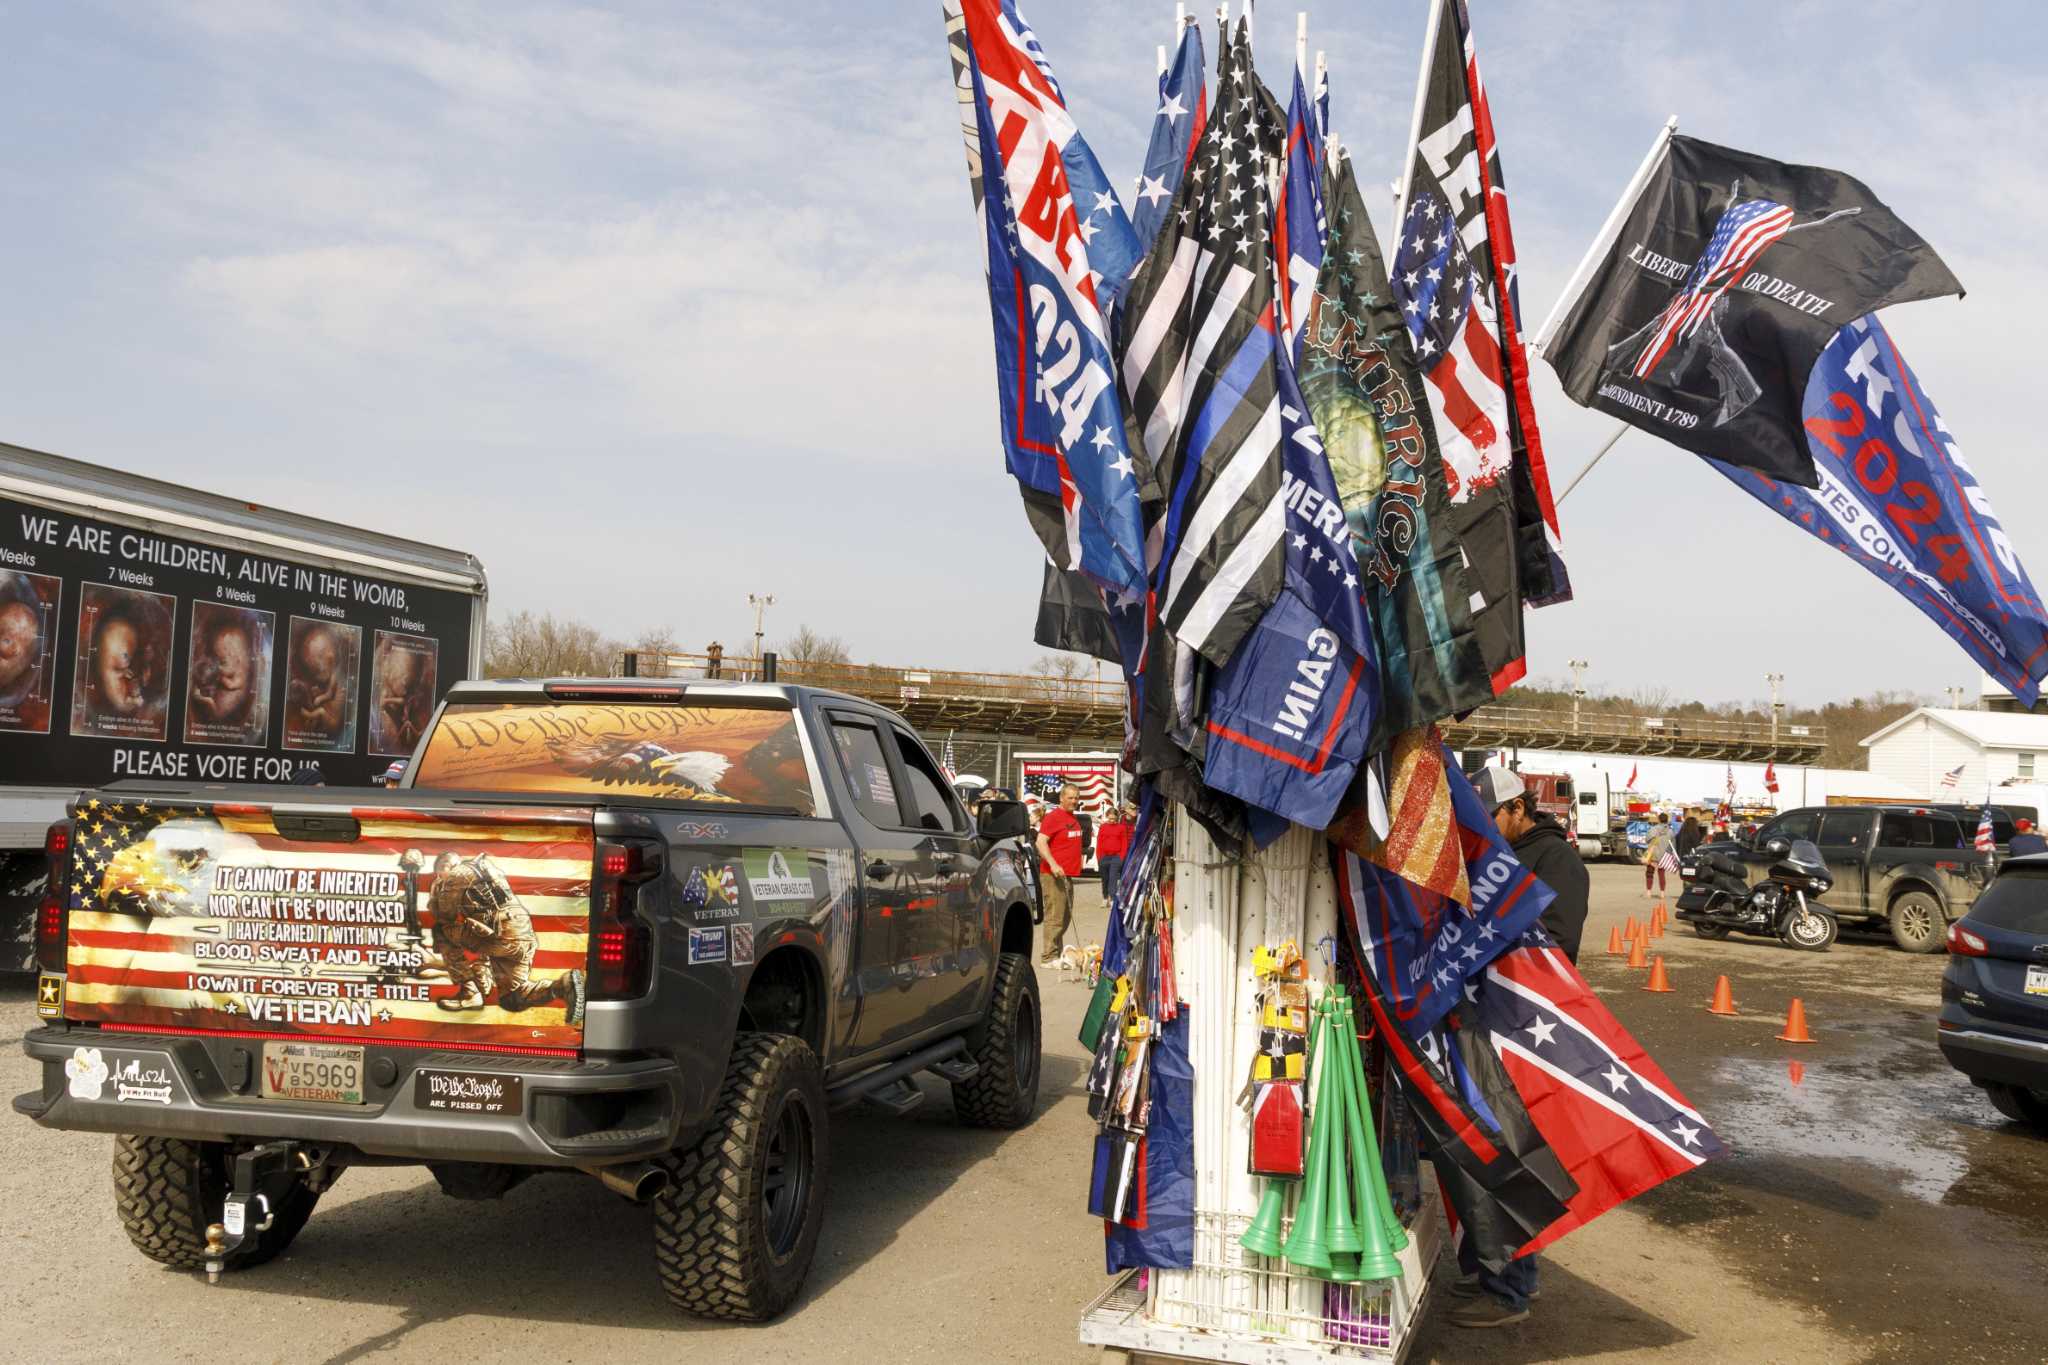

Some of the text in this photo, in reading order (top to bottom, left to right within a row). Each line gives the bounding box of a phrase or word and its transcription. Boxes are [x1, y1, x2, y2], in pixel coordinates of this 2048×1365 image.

[1627, 243, 1835, 316] LIBERTY OR DEATH
[1663, 406, 1698, 429] 1789
[1803, 391, 1973, 583] 2024
[1815, 468, 1861, 524] OTES
[1282, 470, 1353, 555] MERI
[20, 513, 410, 613] WE ARE CHILDREN, ALIVE IN THE WOMB,
[108, 567, 154, 586] 7 Weeks
[216, 585, 256, 604] 8 Weeks
[310, 602, 345, 619] 9 Weeks
[390, 615, 425, 633] 10 Weeks
[444, 716, 533, 750] We
[593, 706, 716, 739] People
[113, 749, 292, 781] PLEASE VOTE FOR
[216, 866, 399, 897] IT CANNOT BE INHERITED
[209, 894, 238, 917] NOR
[294, 899, 313, 920] BE
[316, 900, 405, 924] PURCHASED
[694, 907, 741, 921] VETERAN
[228, 922, 387, 946] I HAVE EARNED IT WITH MY
[702, 931, 722, 942] TRUMP
[195, 943, 422, 967] BLOOD, SWEAT AND TEARS
[188, 975, 429, 1001] I OWN IT FOREVER THE TITLE
[244, 996, 372, 1026] VETERAN
[290, 1062, 300, 1073] V
[303, 1062, 357, 1089] 5969
[286, 1087, 341, 1101] VETERAN
[429, 1075, 449, 1095] We
[464, 1077, 504, 1101] People
[429, 1100, 503, 1112] ARE PISSED OFF
